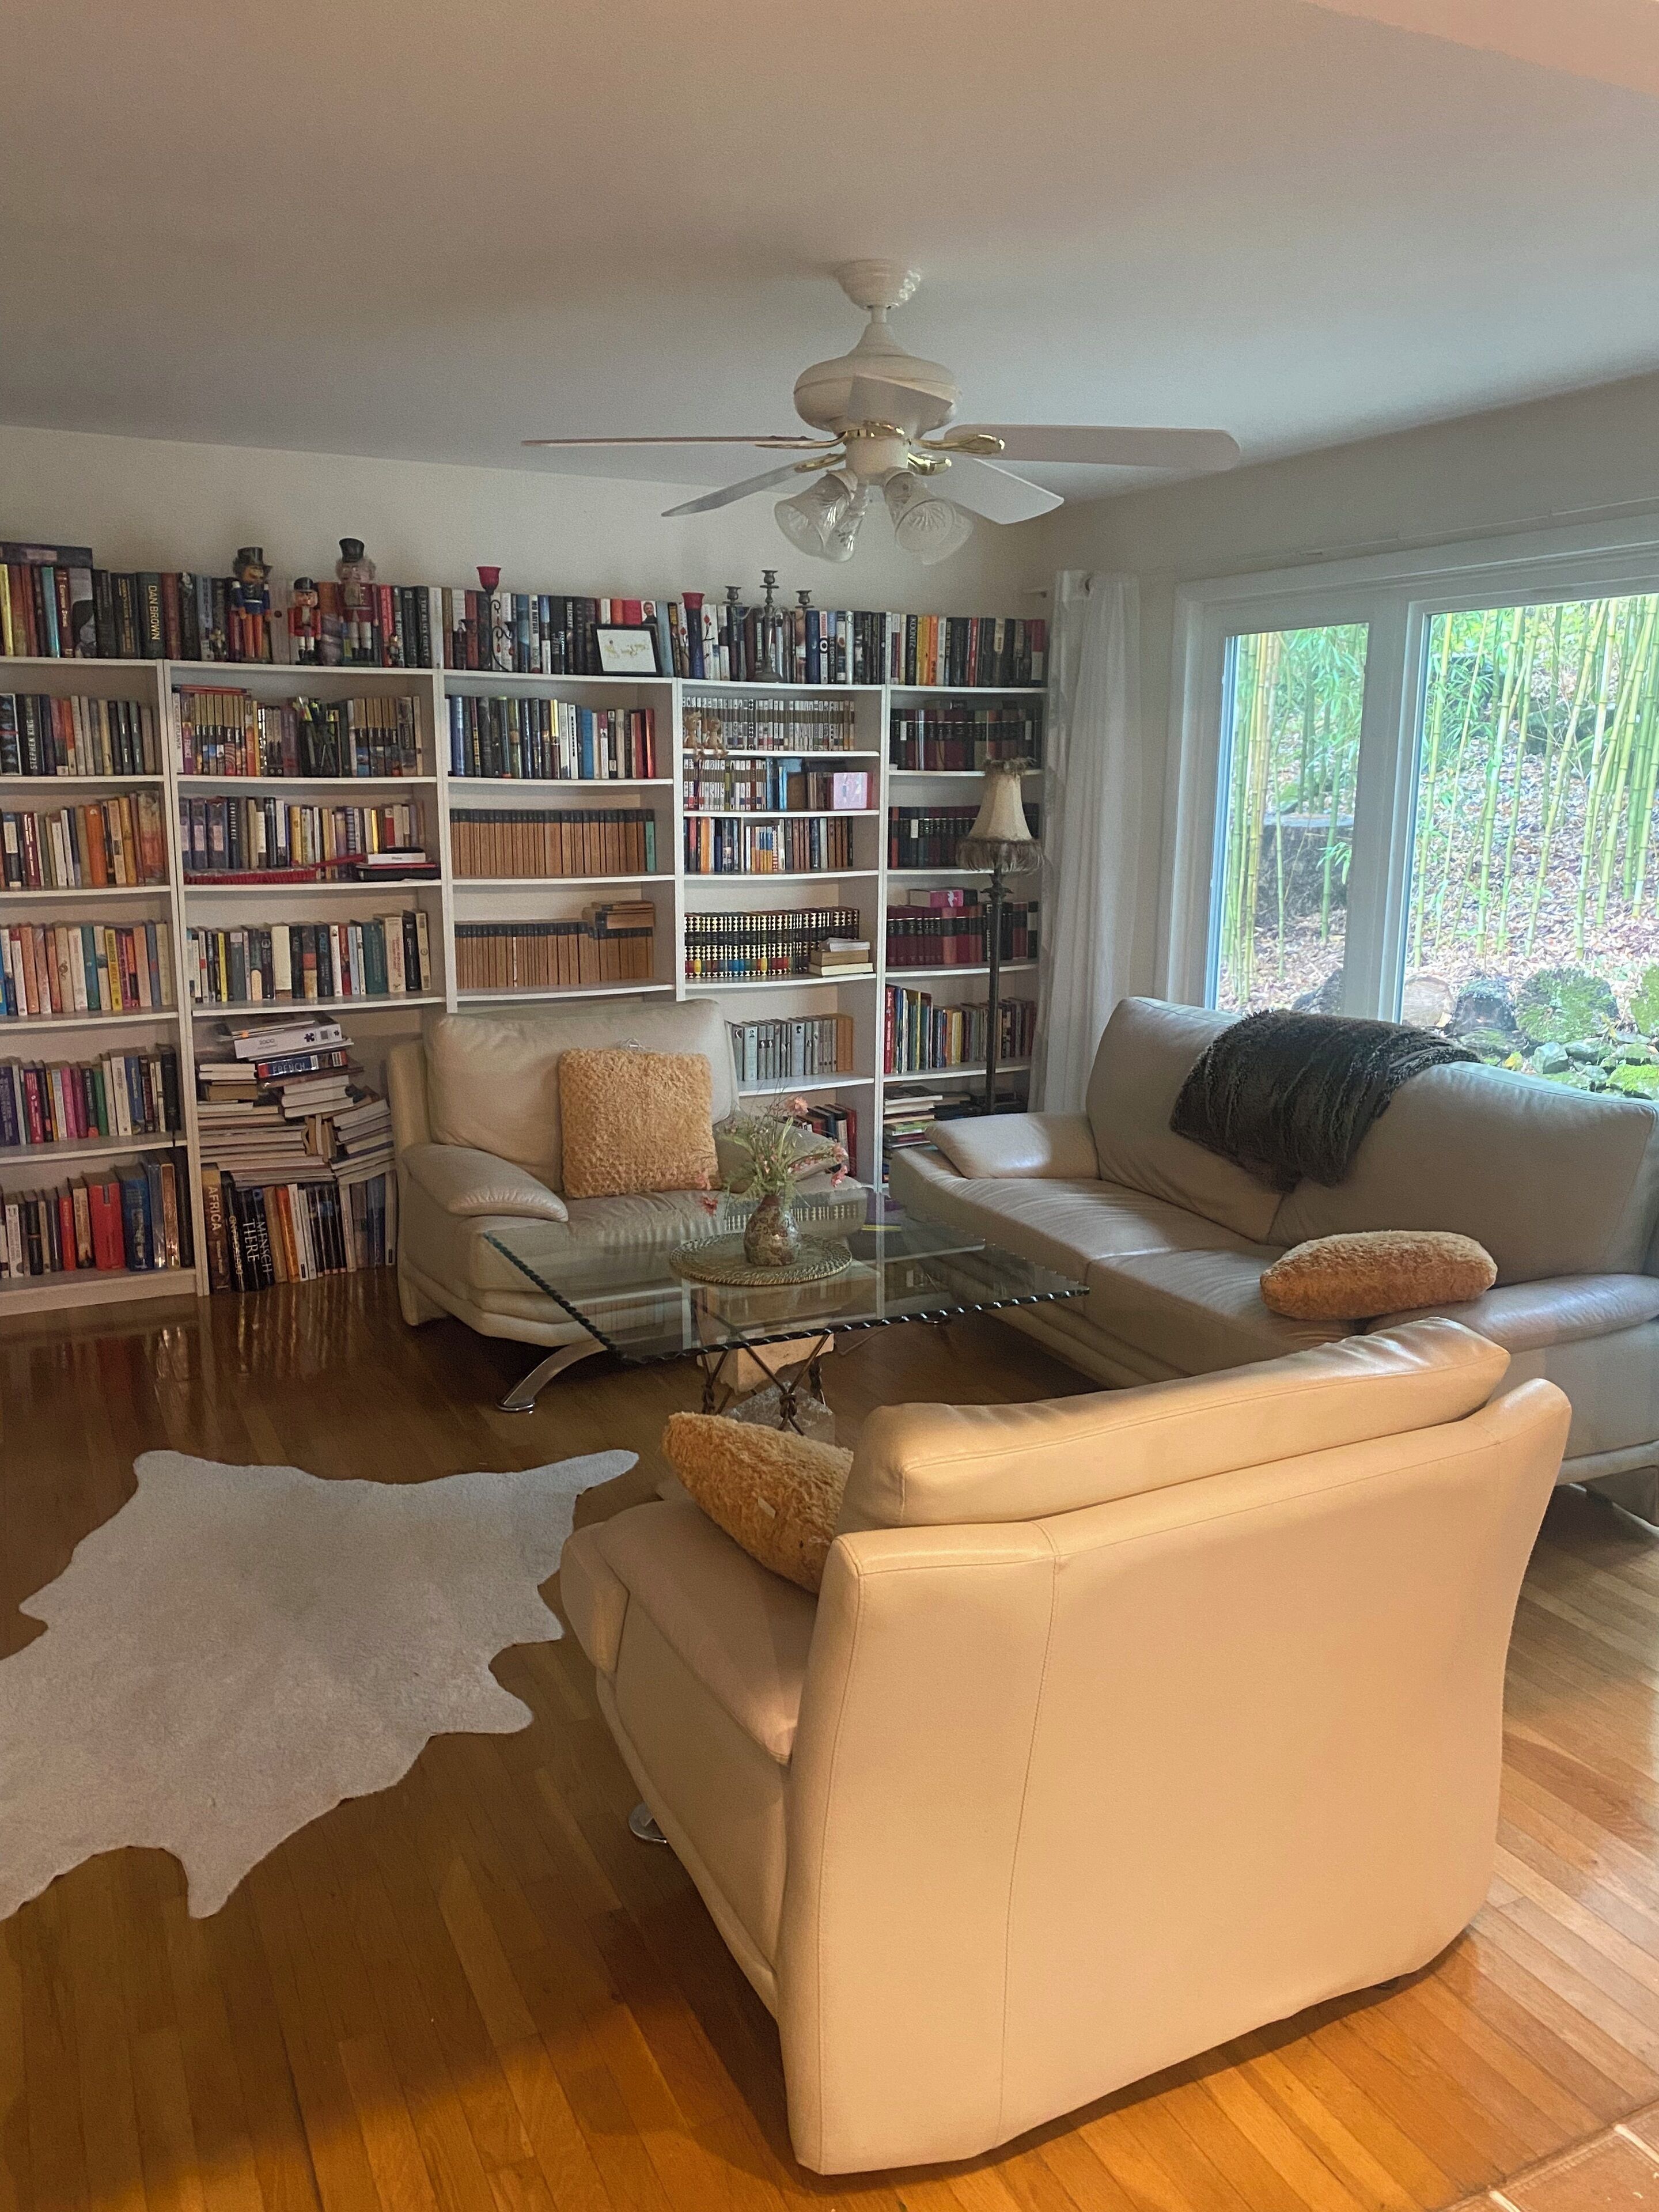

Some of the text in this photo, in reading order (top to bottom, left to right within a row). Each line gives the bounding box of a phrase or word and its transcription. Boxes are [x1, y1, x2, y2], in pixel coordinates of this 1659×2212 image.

[148, 585, 161, 640] DAN BROWN
[532, 600, 538, 610] MO
[26, 719, 37, 770] STEPHEN KING
[272, 1062, 305, 1074] FRENCH
[208, 1186, 222, 1232] AFRICA
[229, 1215, 243, 1275] DEUTSCHLAND
[243, 1218, 260, 1262] TIERE
[256, 1221, 272, 1273] MENSCH
